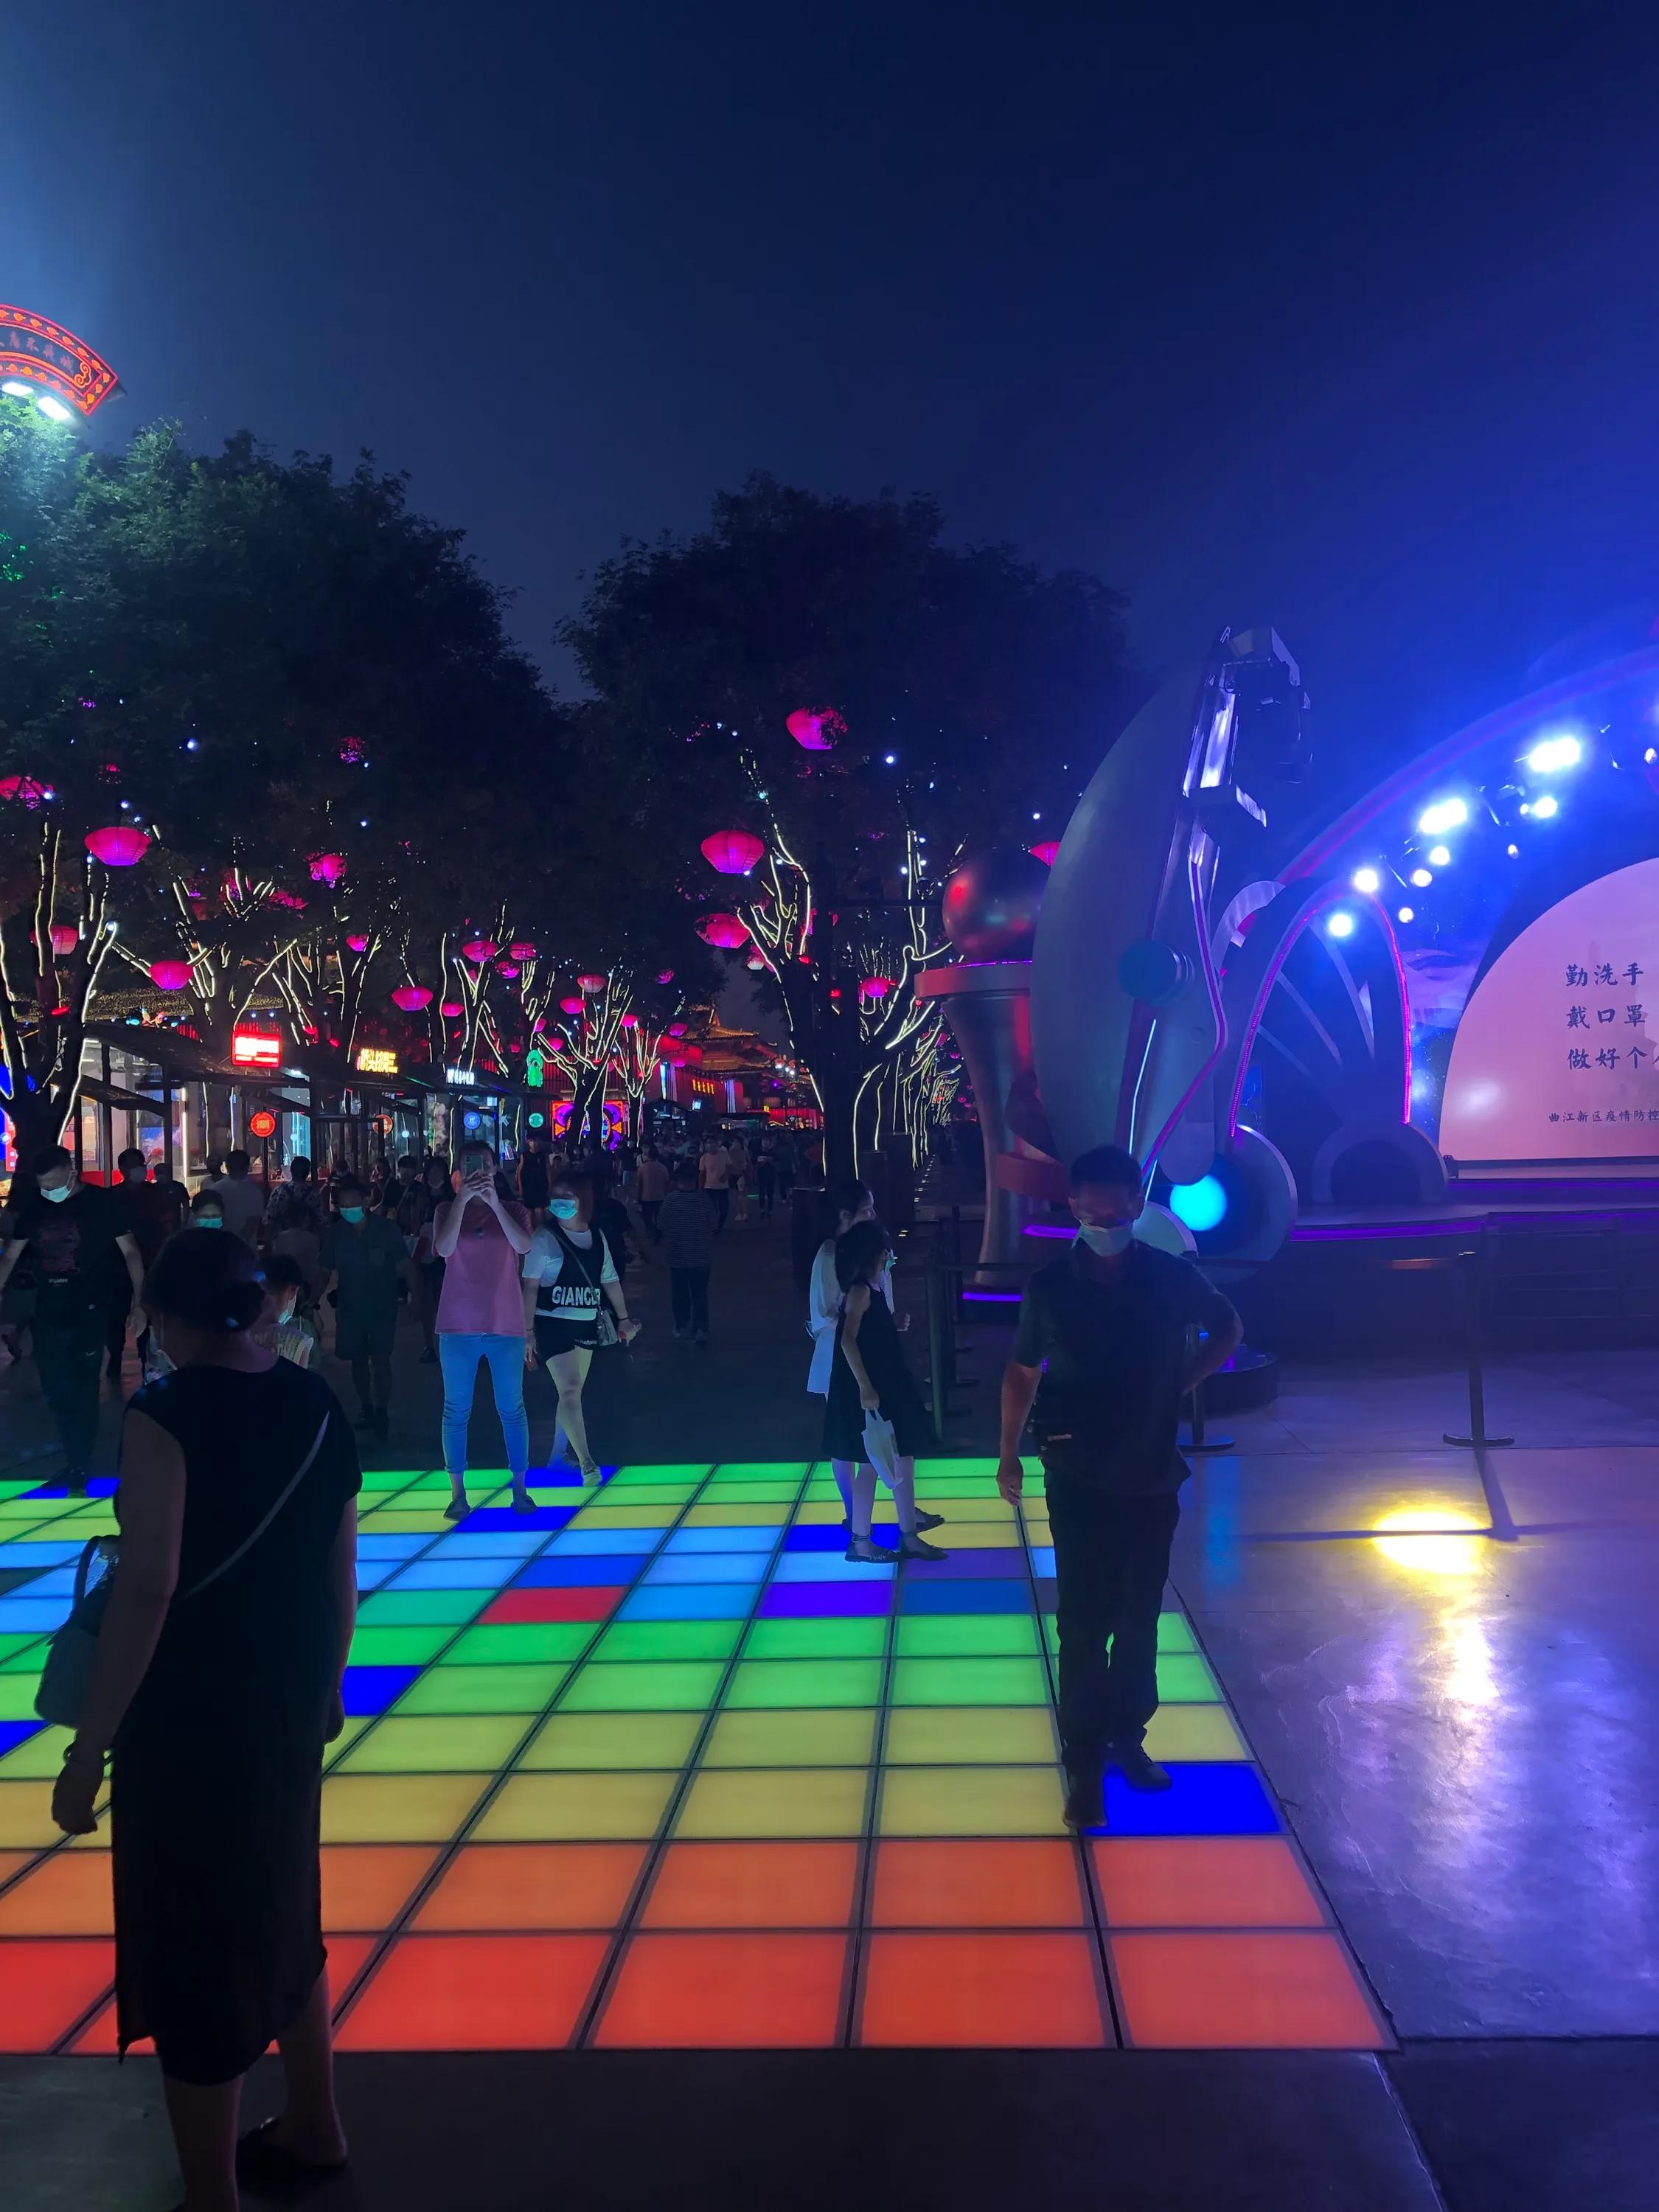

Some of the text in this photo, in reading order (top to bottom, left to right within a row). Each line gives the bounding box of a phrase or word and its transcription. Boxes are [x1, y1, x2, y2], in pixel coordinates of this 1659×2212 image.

[1565, 962, 1644, 987] 勤洗手
[1566, 1004, 1646, 1029] 戴口罩
[1548, 1108, 1659, 1123] 曲江新区疫情防控
